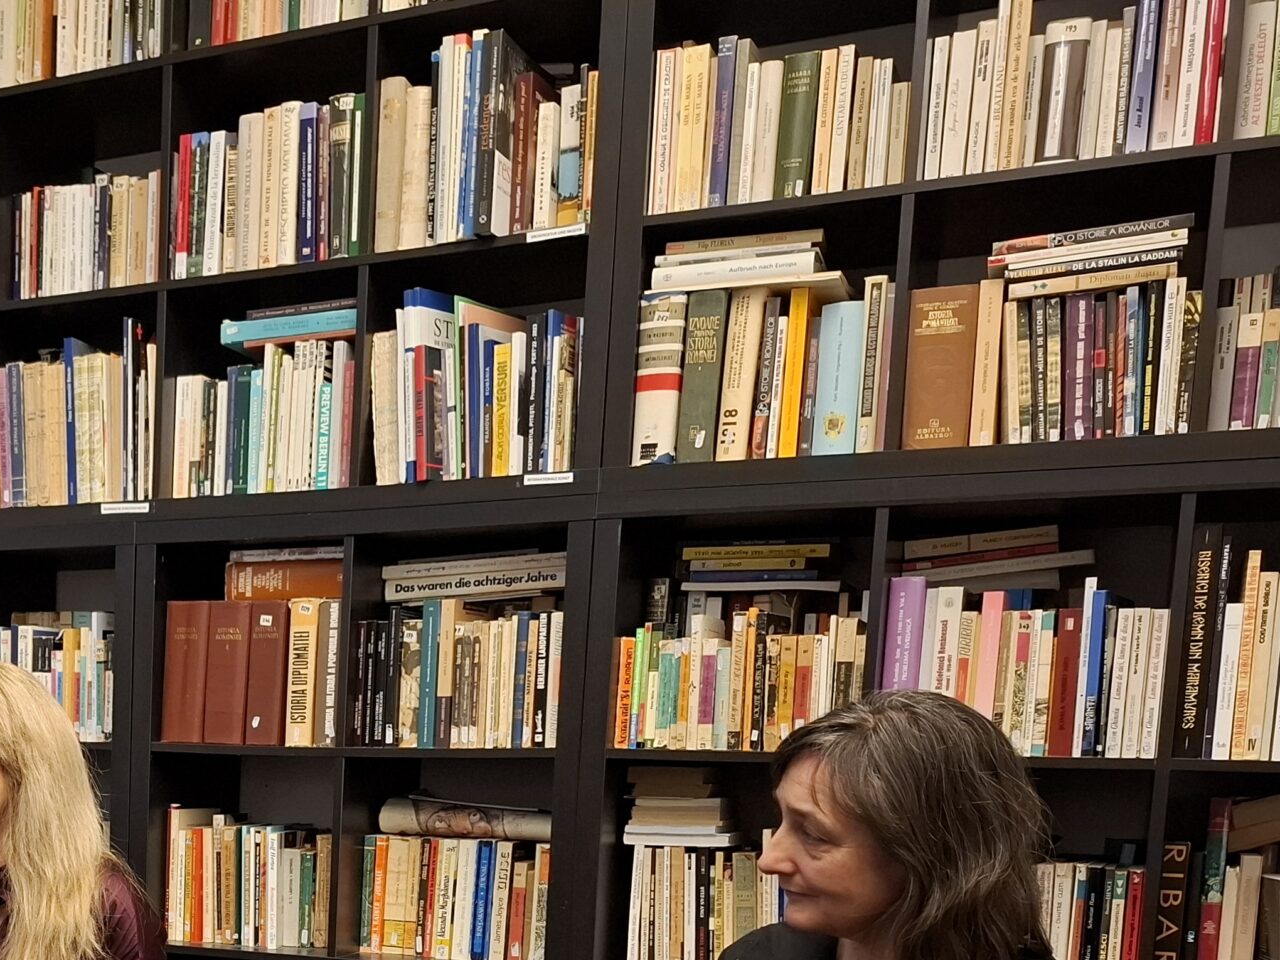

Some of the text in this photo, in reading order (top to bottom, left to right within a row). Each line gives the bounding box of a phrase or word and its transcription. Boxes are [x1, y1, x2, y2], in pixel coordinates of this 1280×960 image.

[1077, 230, 1107, 241] ISTORIE
[1098, 257, 1126, 267] STALIN
[1129, 255, 1139, 263] LA
[1141, 250, 1177, 262] SADDAM
[687, 336, 717, 350] ISTORIA
[496, 360, 507, 413] VERSURI
[760, 367, 770, 391] ISTORIE
[319, 387, 331, 433] PREVIEW
[317, 437, 329, 472] BERLIN
[395, 571, 558, 594] Das waren die achtziger Jahre
[537, 613, 548, 689] BERLINER LANDPARTIEN
[1188, 642, 1203, 659] DIN
[290, 688, 307, 724] ISTORIA
[494, 897, 504, 919] Joyce
[493, 920, 502, 944] James
